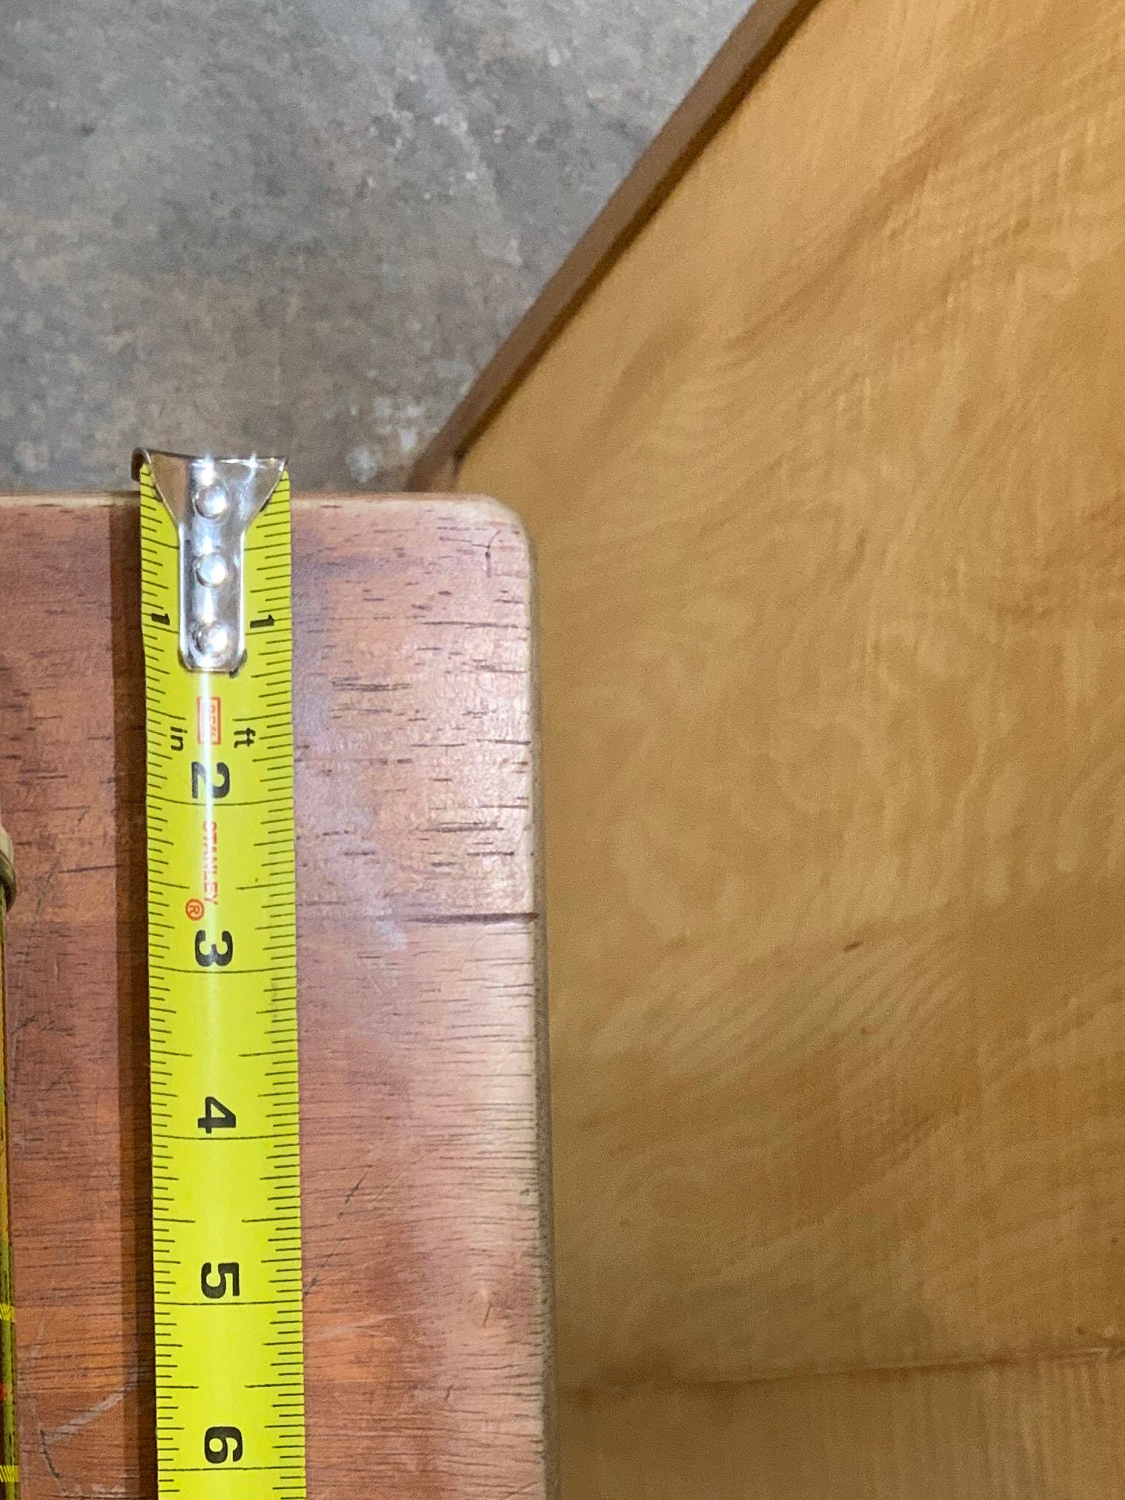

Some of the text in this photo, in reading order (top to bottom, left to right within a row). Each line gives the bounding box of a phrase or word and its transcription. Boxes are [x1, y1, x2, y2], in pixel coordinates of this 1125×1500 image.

[170, 726, 188, 752] in
[233, 727, 256, 749] ft
[191, 761, 231, 799] 2
[194, 929, 234, 967] 3
[197, 1096, 237, 1134] 4
[200, 1261, 240, 1299] 5
[204, 1426, 244, 1465] 6
